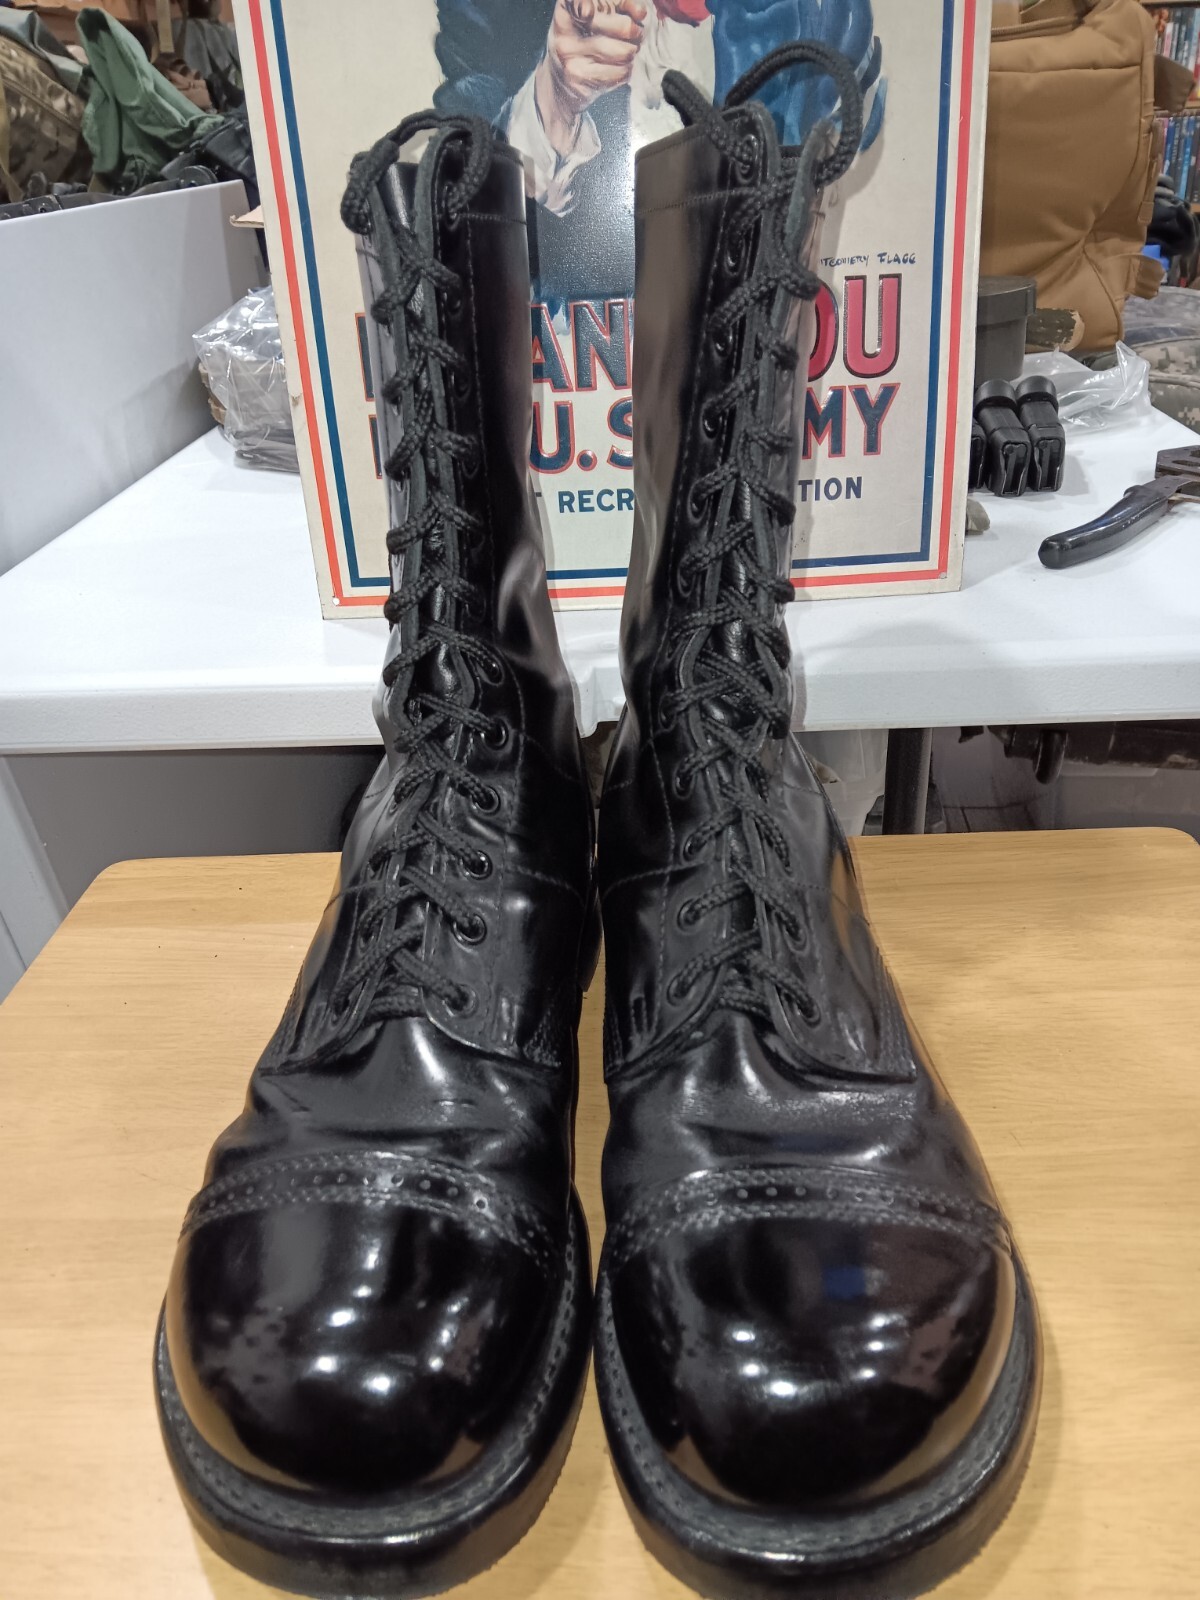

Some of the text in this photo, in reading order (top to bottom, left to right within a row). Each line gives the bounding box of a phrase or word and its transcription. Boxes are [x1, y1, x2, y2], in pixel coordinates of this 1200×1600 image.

[877, 251, 916, 264] FLAGG
[531, 299, 633, 393] AN
[802, 382, 901, 460] MY
[557, 476, 863, 513] RECR TION
